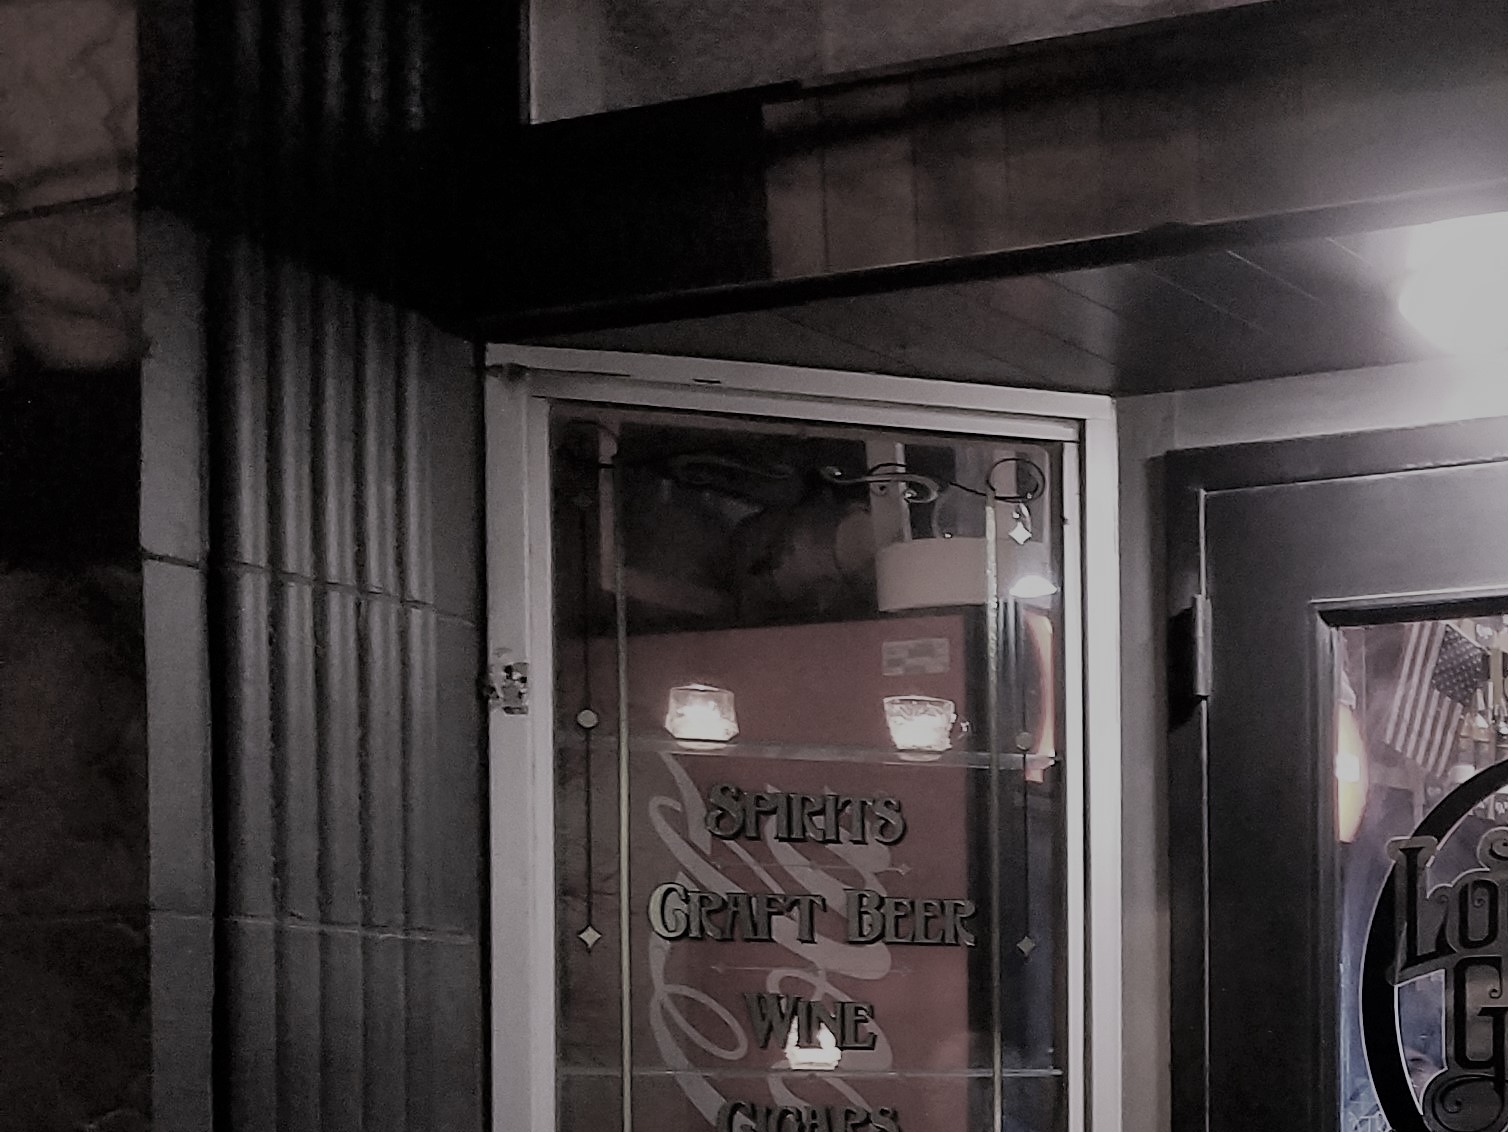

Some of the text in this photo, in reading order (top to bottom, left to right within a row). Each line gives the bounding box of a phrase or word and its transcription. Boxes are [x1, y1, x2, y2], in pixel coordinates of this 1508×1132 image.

[704, 783, 907, 845] SPIRITS
[647, 882, 978, 948] CRAFT BEER
[744, 991, 878, 1052] WINE
